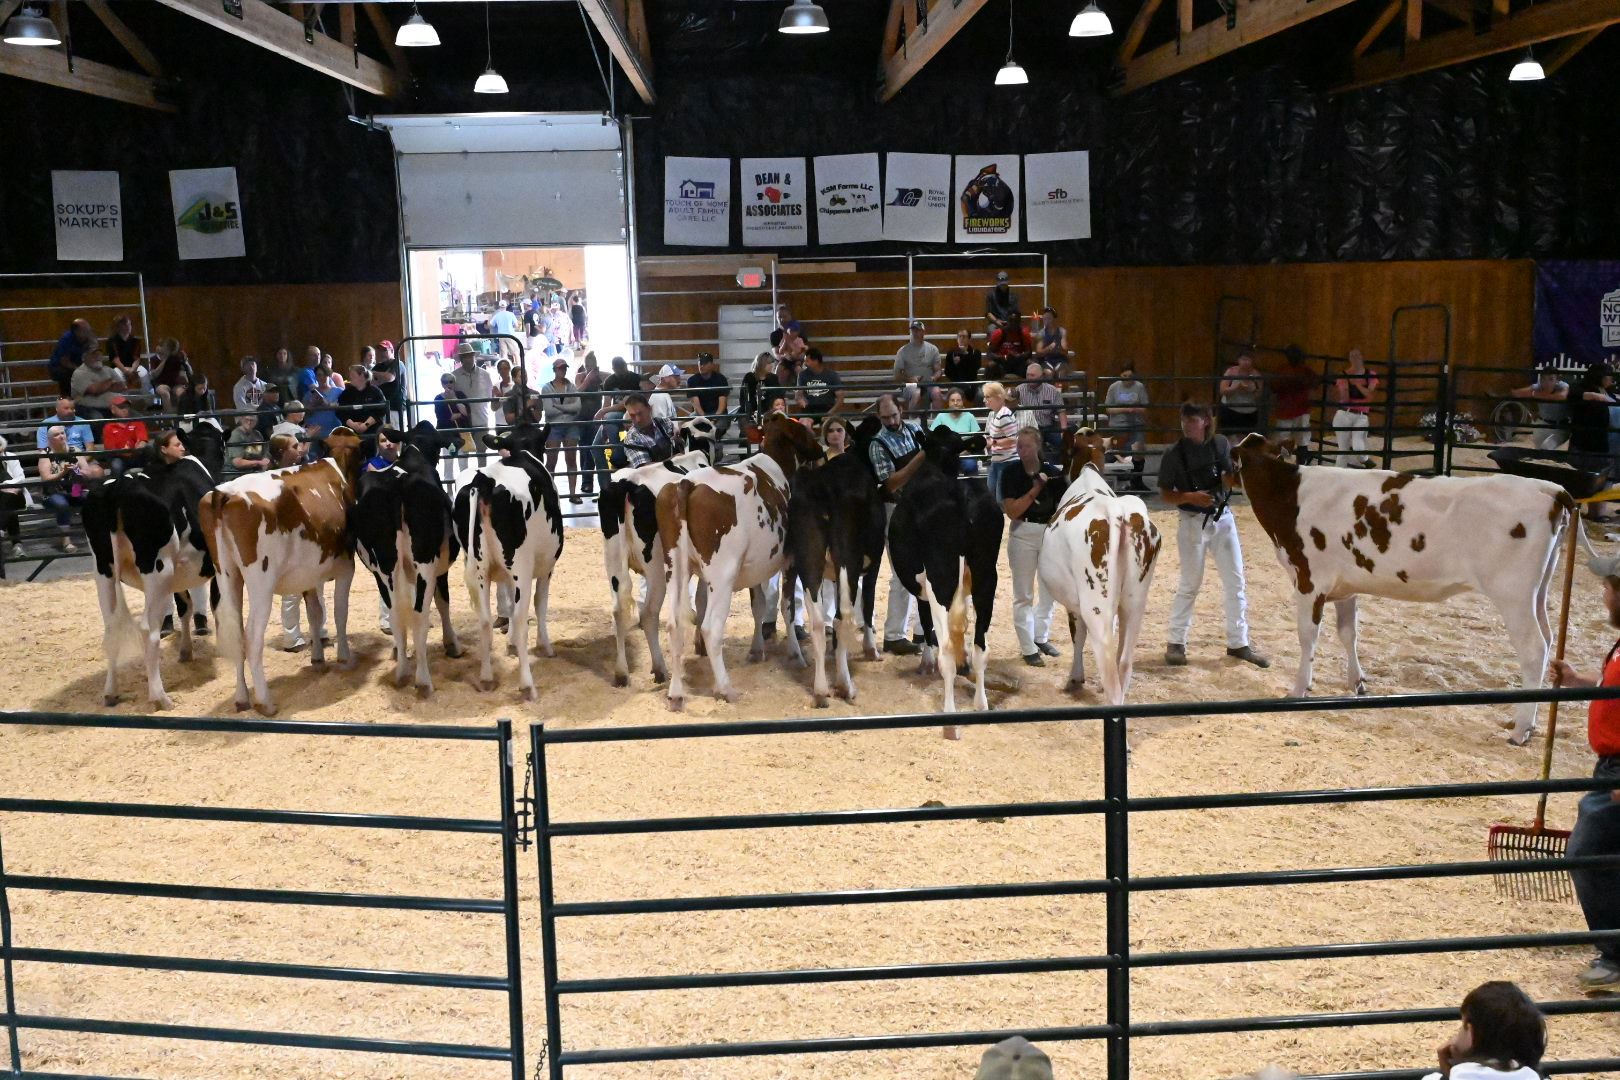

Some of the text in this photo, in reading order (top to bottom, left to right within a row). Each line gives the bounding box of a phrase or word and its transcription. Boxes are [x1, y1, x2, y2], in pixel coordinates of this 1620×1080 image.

[755, 172, 792, 187] DEAN &
[820, 184, 836, 196] KSM
[860, 183, 874, 192] LLC
[1047, 188, 1068, 200] sfb
[56, 203, 118, 215] SOKUP'S
[198, 201, 238, 220] J&S
[745, 203, 802, 217] ASSOCIATES
[819, 207, 851, 215] Chippewa
[59, 217, 118, 228] MARKET
[964, 216, 1010, 228] FIREWORKS
